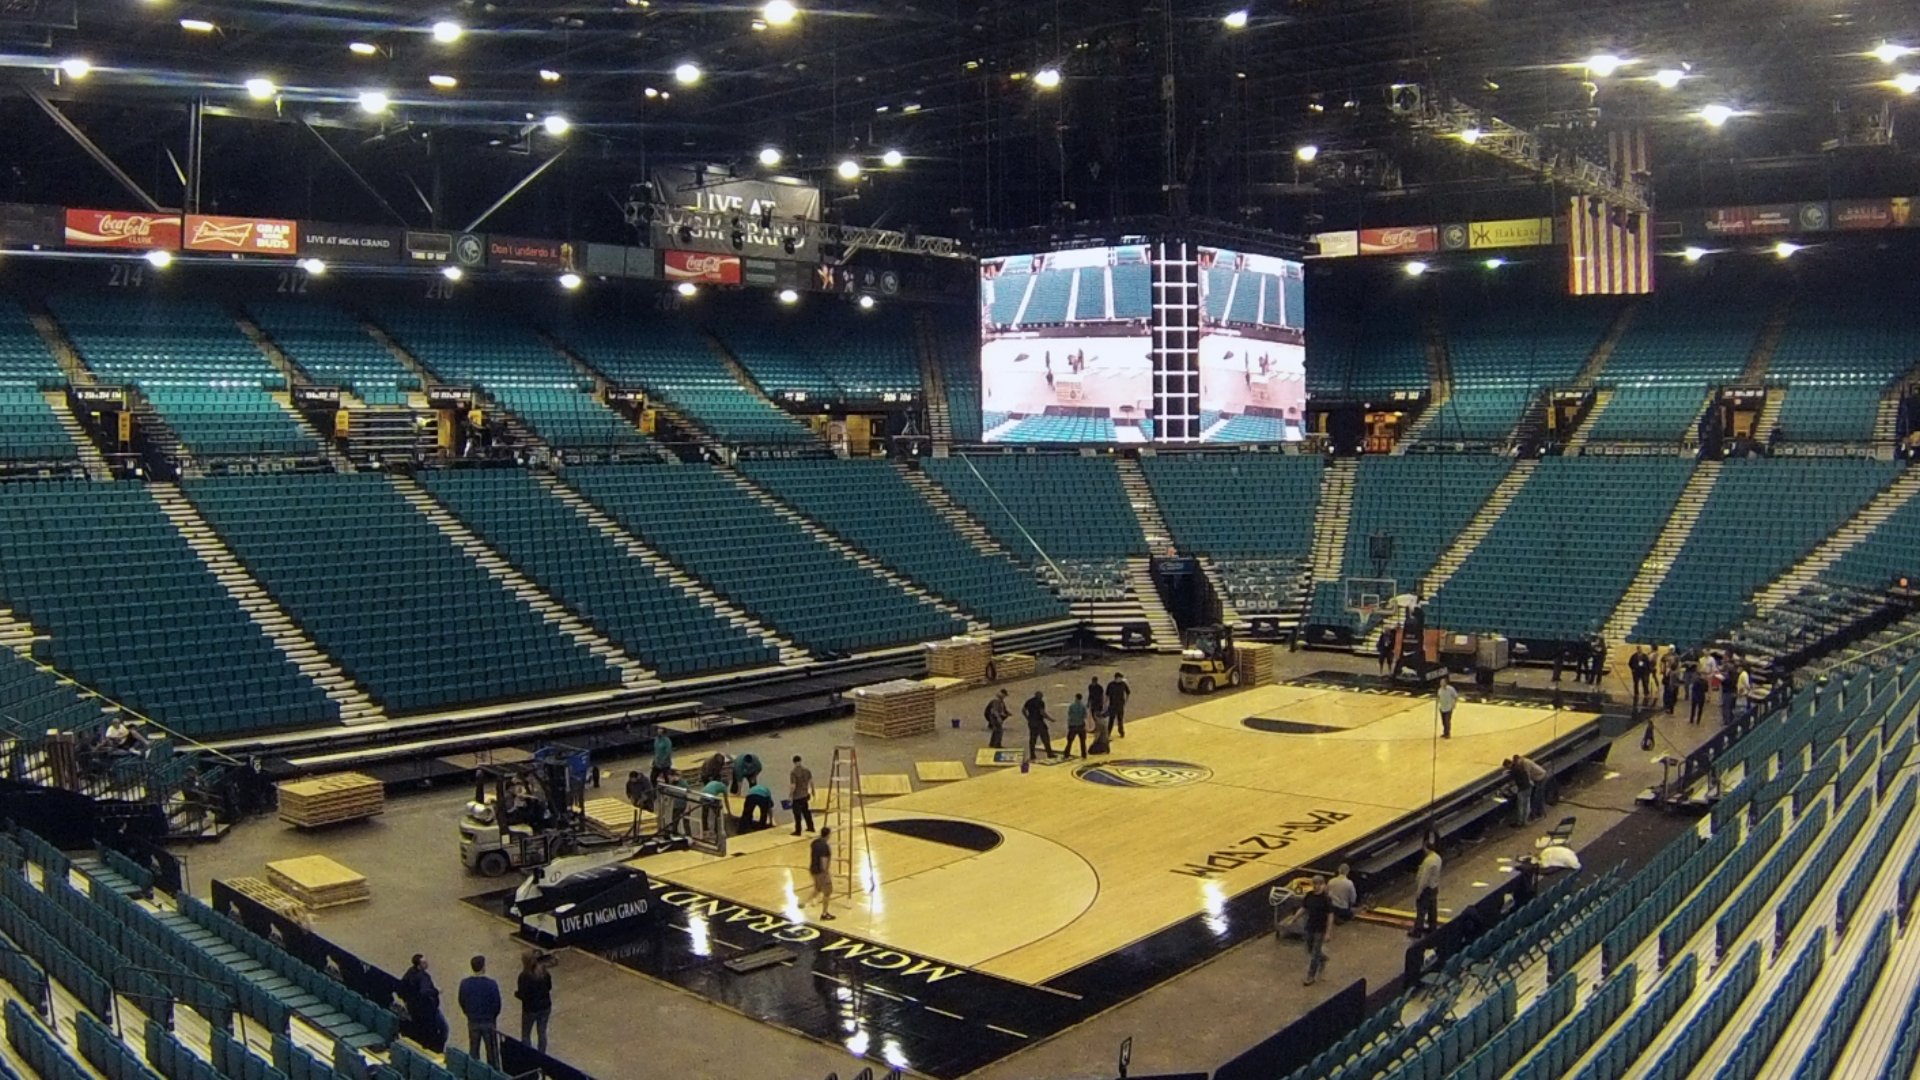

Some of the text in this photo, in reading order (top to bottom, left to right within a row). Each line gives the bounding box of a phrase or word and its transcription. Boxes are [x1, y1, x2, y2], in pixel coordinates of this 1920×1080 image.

[256, 223, 291, 235] GRAB
[256, 238, 290, 249] BUDS
[305, 234, 391, 249] LIVE AT MGM GRAND
[109, 265, 142, 286] 214
[278, 272, 308, 294] 212
[561, 898, 648, 933] LIVE AT MGM GRAND
[660, 891, 967, 984] MGM GRAND
